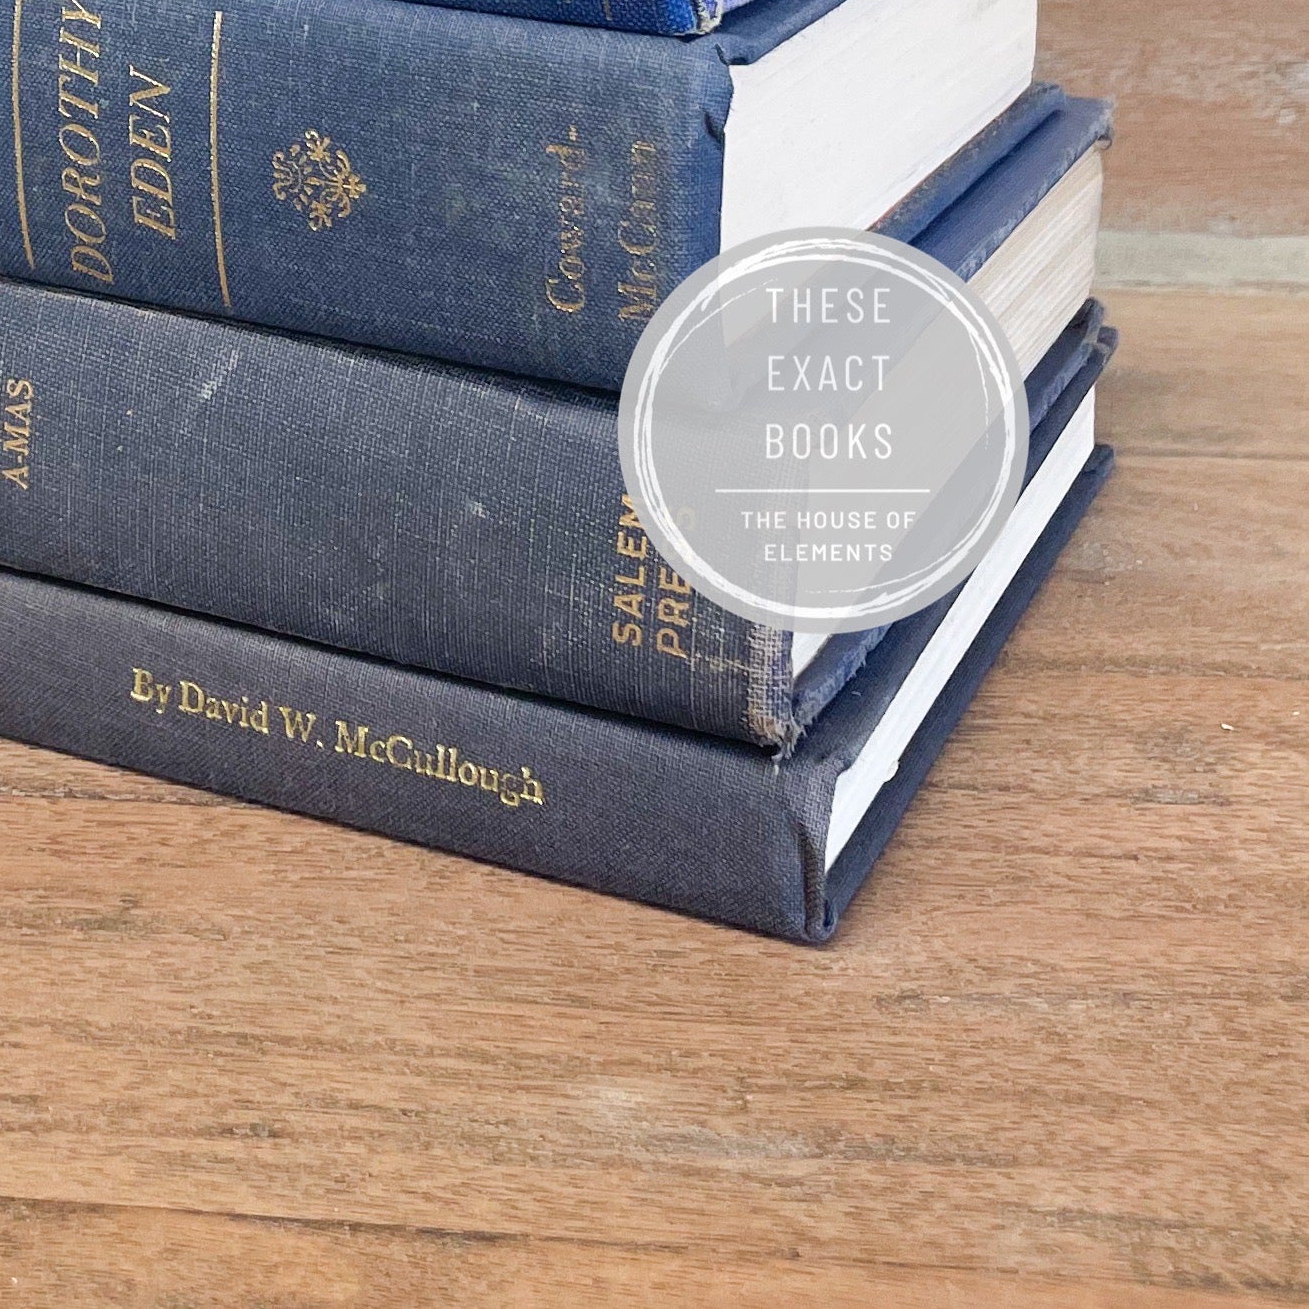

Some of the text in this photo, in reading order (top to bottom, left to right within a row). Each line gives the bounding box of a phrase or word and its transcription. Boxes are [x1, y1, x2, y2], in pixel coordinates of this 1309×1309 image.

[128, 64, 177, 240] EDEN
[0, 378, 34, 490] A-MAS
[611, 493, 647, 647] SALEM
[130, 667, 546, 807] By David W. McCullough
